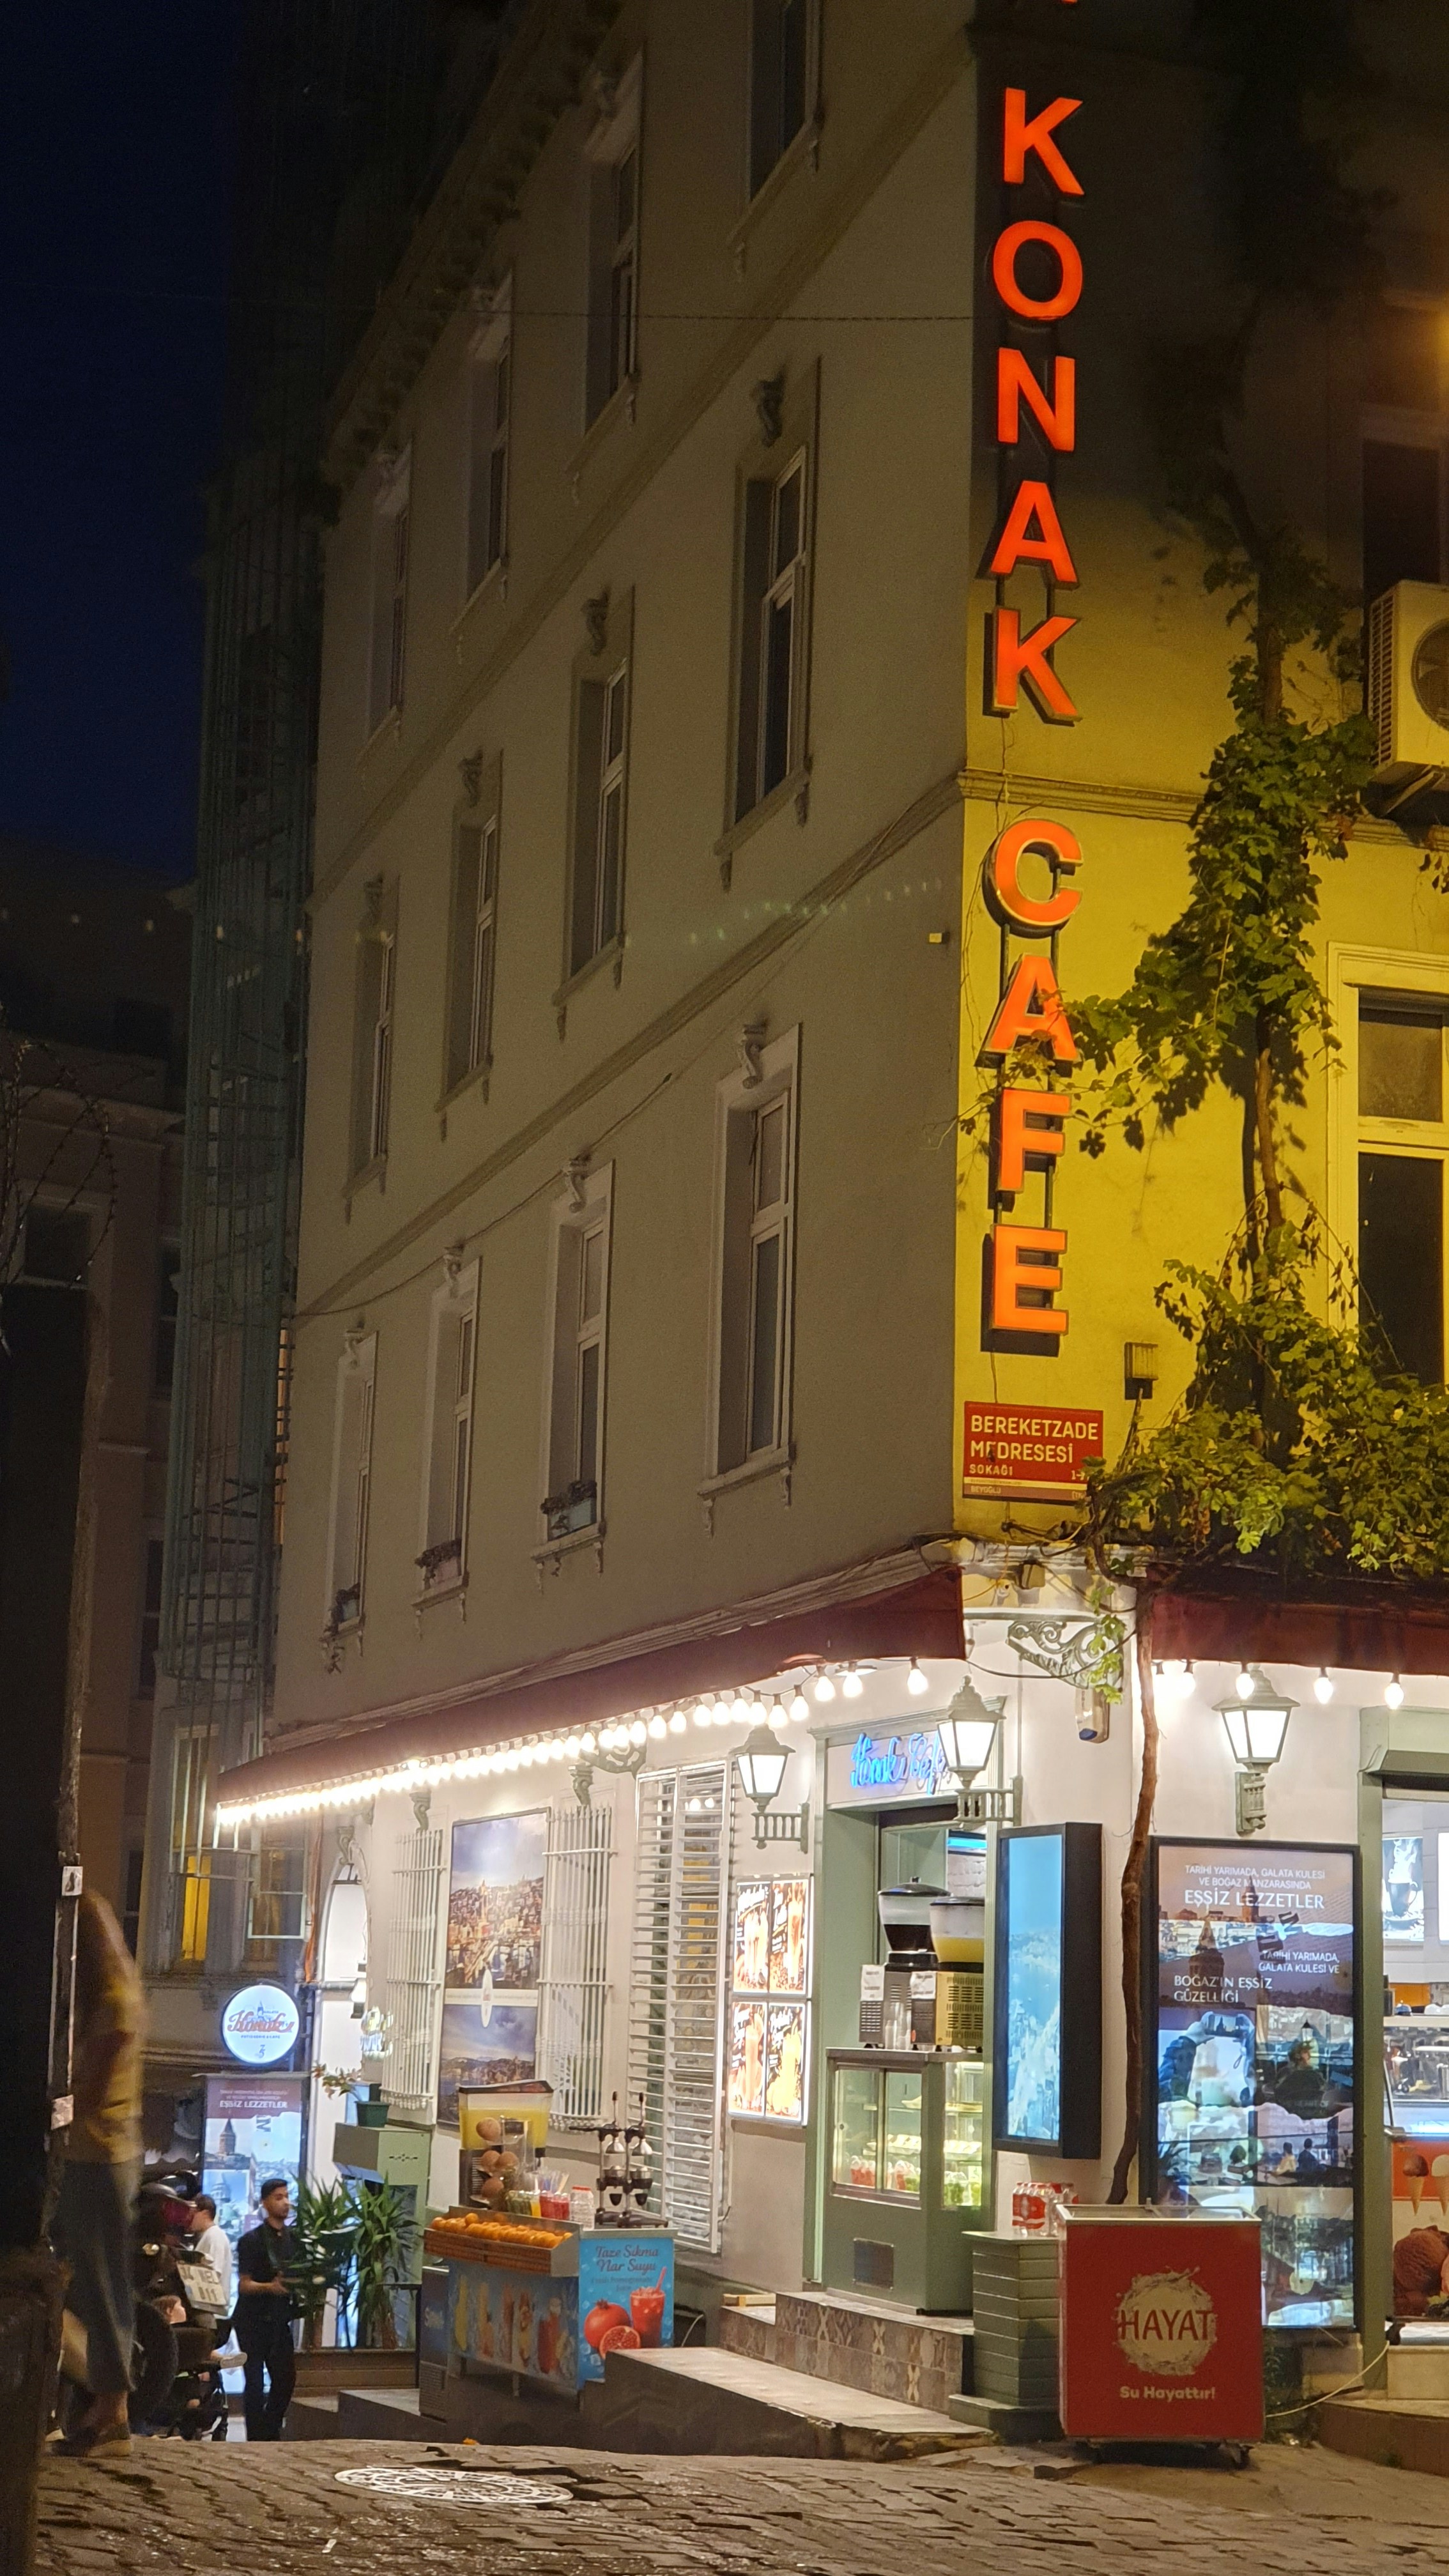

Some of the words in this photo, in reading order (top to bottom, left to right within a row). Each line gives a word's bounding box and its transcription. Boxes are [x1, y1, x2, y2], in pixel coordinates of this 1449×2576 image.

[993, 87, 1085, 718] KONAK
[988, 818, 1084, 1335] CAFE
[970, 1414, 1098, 1441] BEREKETZADE
[969, 1464, 1013, 1476] SOKAĞI
[970, 1485, 1001, 1494] BEYOĞLU
[1185, 1865, 1212, 1874] TARİHİ
[1261, 1868, 1294, 1878] GALATA
[1295, 1869, 1326, 1879] KULESİ
[1199, 1877, 1209, 1887] VE
[1212, 1876, 1242, 1887] BOĞAZ
[1184, 1888, 1230, 1908] EŞSİZ
[1236, 1891, 1324, 1909] LEZZETLER
[1292, 1951, 1340, 1963] YARIMADA,
[1258, 1962, 1293, 1972] GALATA
[1295, 1963, 1327, 1974] KULESİ
[1328, 1965, 1340, 1974] VE
[1174, 1972, 1234, 1988] BOĞAZ'IN
[1238, 1974, 1273, 1991] EŞSİZ
[1174, 1988, 1239, 2004] GÜZELLİĞİ
[595, 2245, 621, 2258] Taze
[596, 2258, 625, 2273] Nar
[627, 2258, 656, 2276] Suyu
[1120, 2309, 1214, 2341] HAYAT
[1119, 2386, 1140, 2399] Su
[1143, 2385, 1216, 2403] Hayattır!
